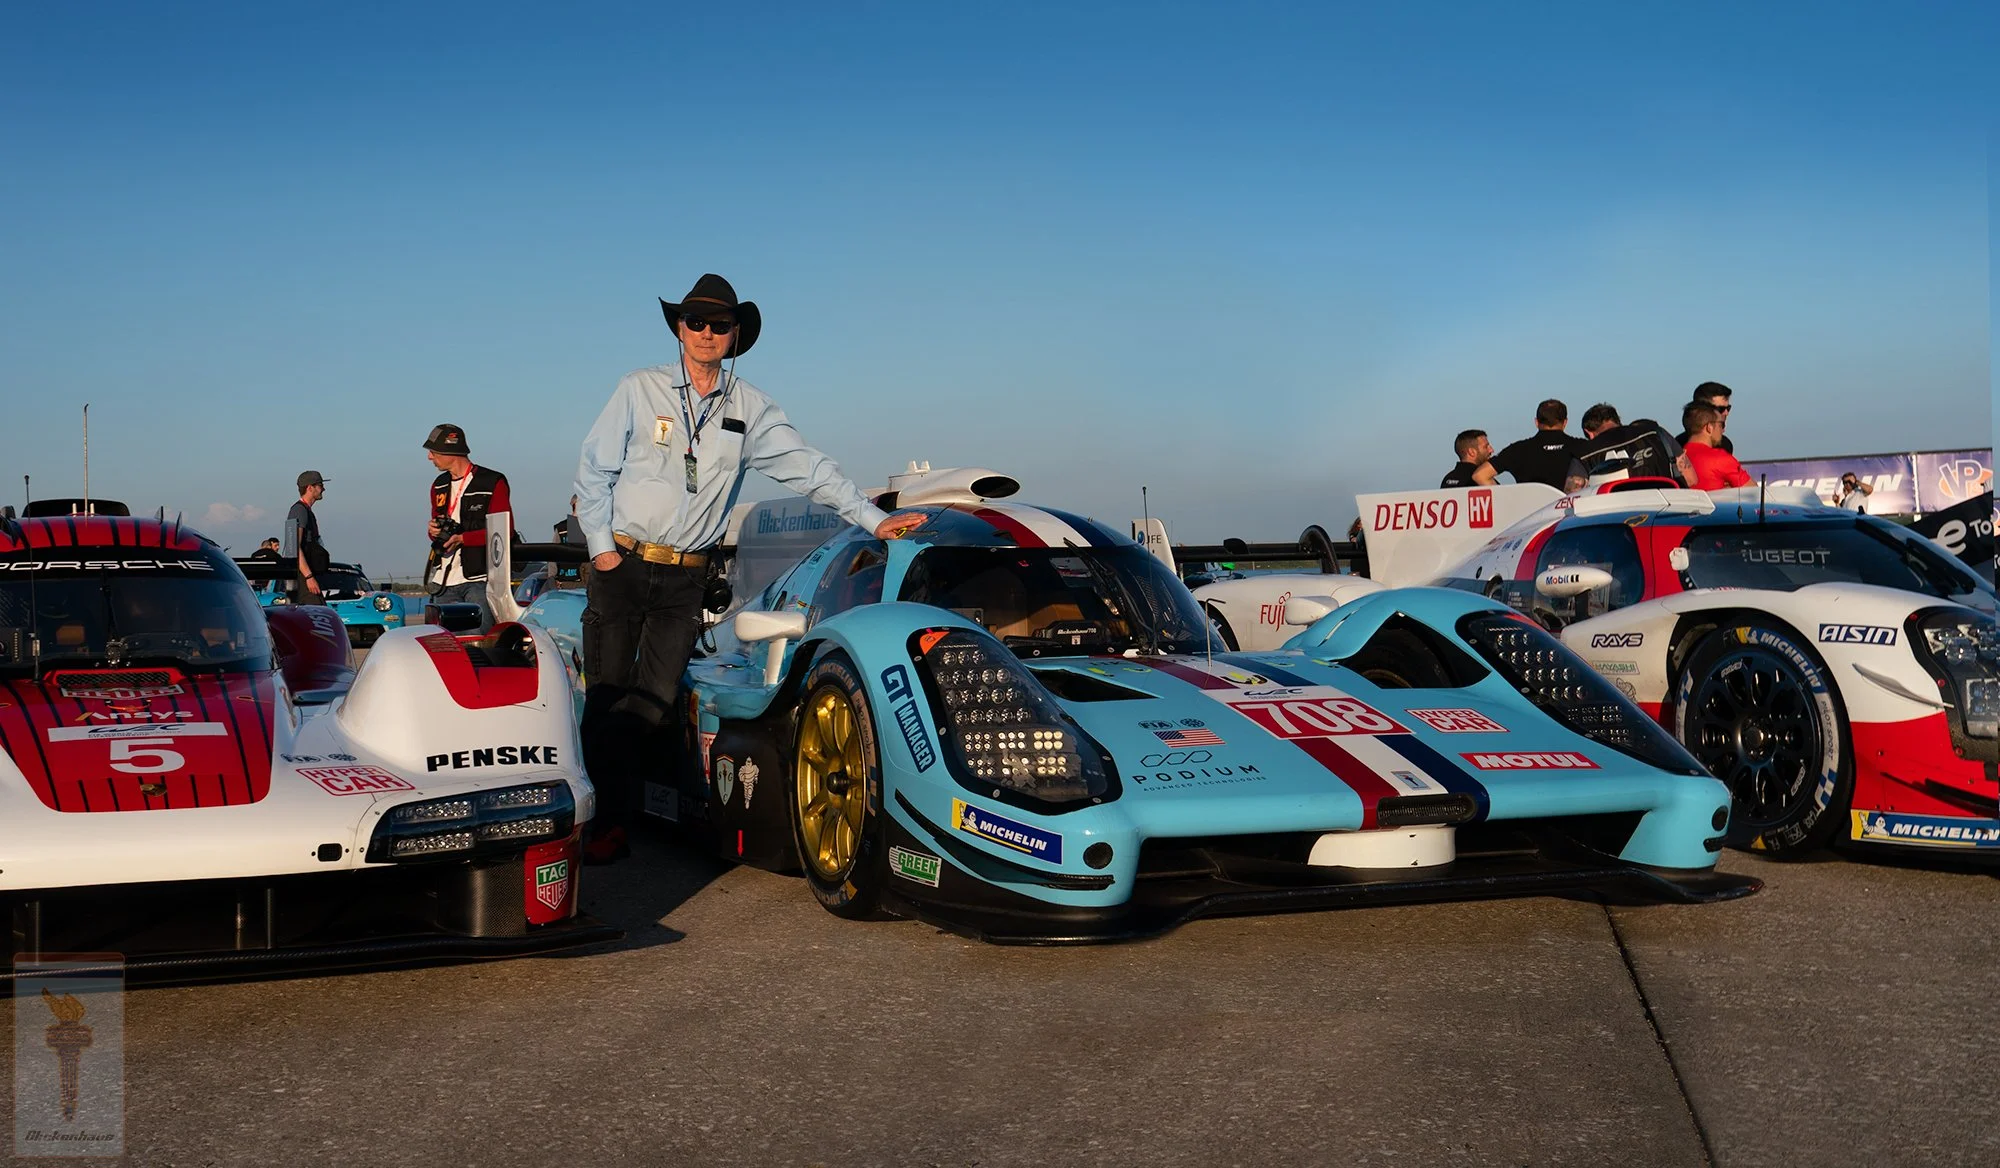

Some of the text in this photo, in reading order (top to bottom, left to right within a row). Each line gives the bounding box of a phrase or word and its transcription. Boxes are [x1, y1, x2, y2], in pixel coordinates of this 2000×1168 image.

[1939, 459, 1983, 499] VP
[757, 505, 839, 534] Glickenhaus
[1374, 496, 1491, 531] DENSO HY
[1146, 534, 1162, 544] JFE
[1545, 575, 1569, 585] Mobil
[1591, 633, 1644, 648] RAYS
[1820, 625, 1895, 645] AISIN
[1594, 663, 1636, 673] HAYASHI
[1760, 632, 1822, 688] MICHELIN
[881, 664, 934, 771] GT MANAGER
[1235, 700, 1394, 735] 708
[1411, 709, 1482, 719] HYPER
[1427, 717, 1499, 731] CAR
[109, 737, 185, 773] 5
[427, 746, 558, 772] PENSKE
[1472, 754, 1592, 768] MOTUL
[305, 767, 384, 779] HYPER
[1132, 764, 1260, 785] PODIUM
[321, 775, 404, 792] CAR
[1143, 776, 1267, 792] ADVANCED TECHNOLOGIES
[980, 820, 1047, 851] MICHELIN
[1891, 823, 1999, 840] MICHELIN
[540, 864, 566, 882] TAG
[898, 852, 938, 875] GREEN
[539, 880, 567, 906] HEUER
